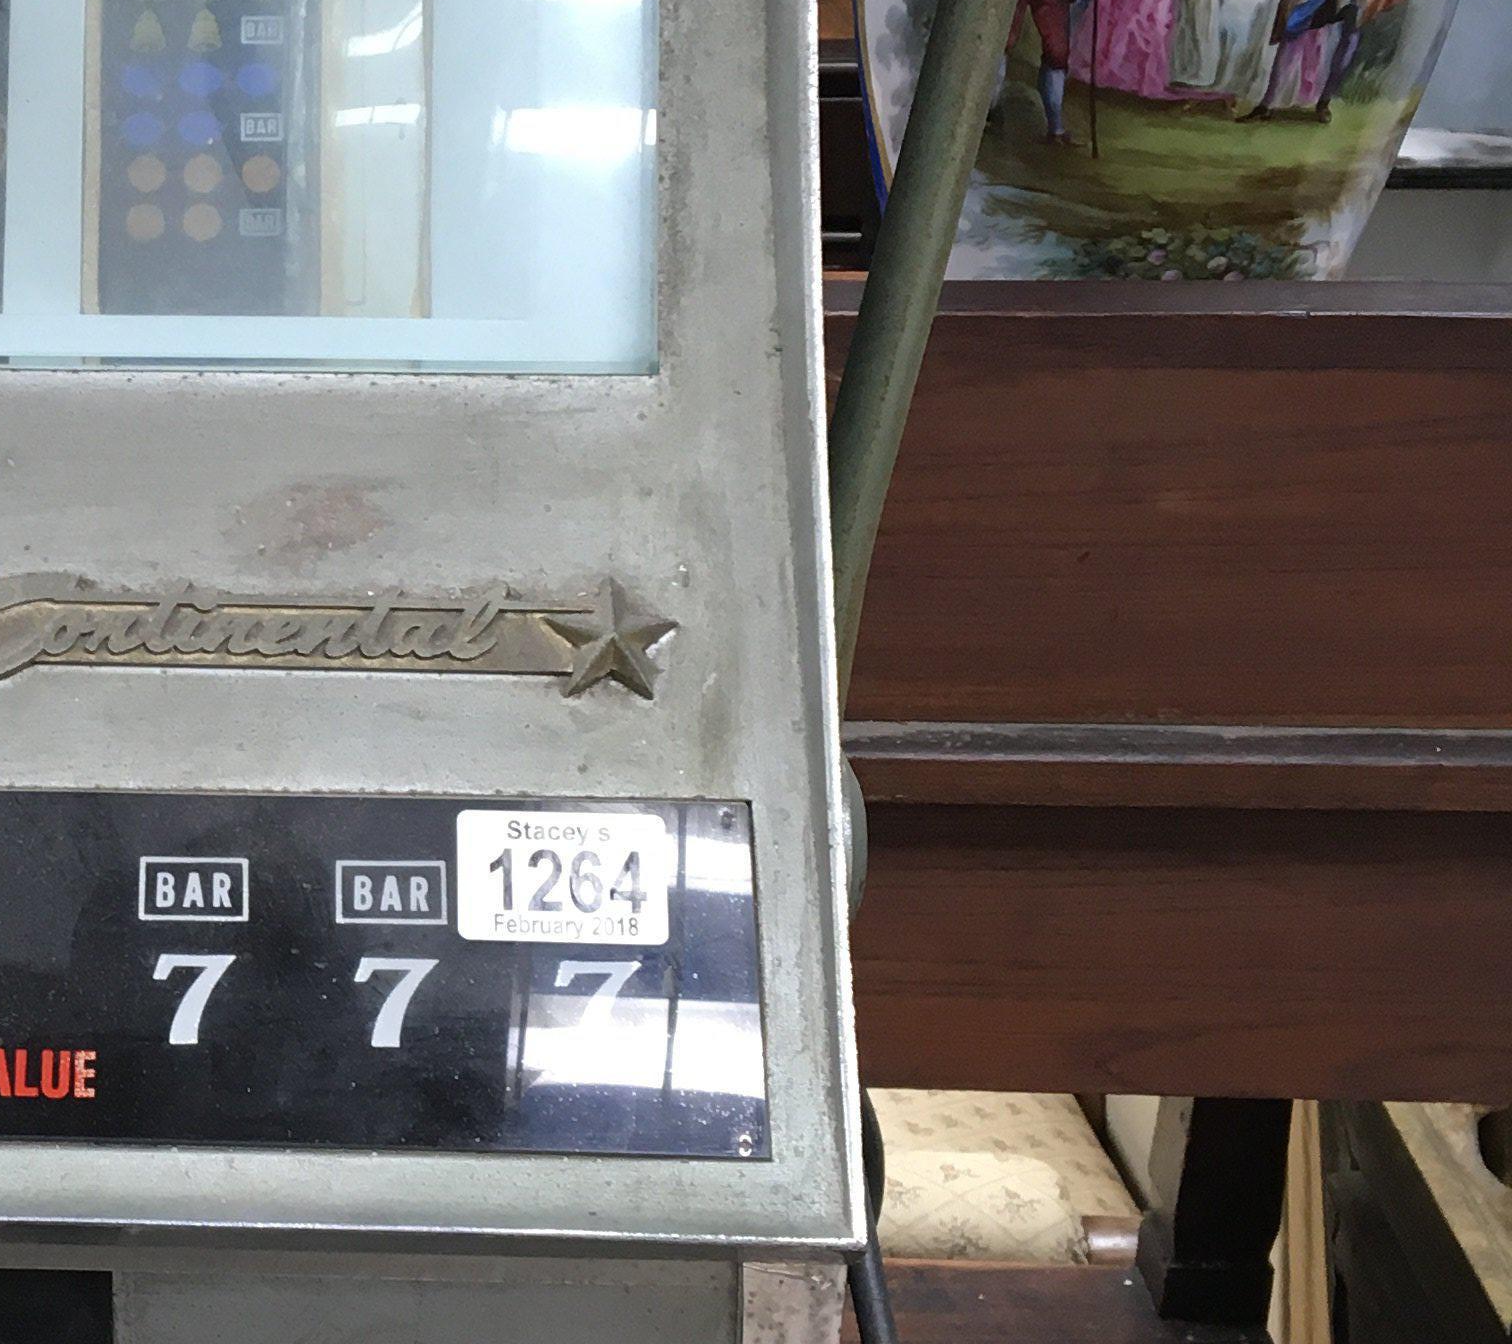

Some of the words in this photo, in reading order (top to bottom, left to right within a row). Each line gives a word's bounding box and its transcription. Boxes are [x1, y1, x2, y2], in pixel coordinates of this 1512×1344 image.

[155, 872, 233, 908] BAR
[352, 875, 430, 912] BAR
[489, 848, 648, 914] 1264
[494, 914, 583, 939] February
[592, 917, 640, 937] 2018
[152, 953, 237, 1045] 7
[353, 957, 439, 1048] 7
[553, 960, 642, 1048] 7
